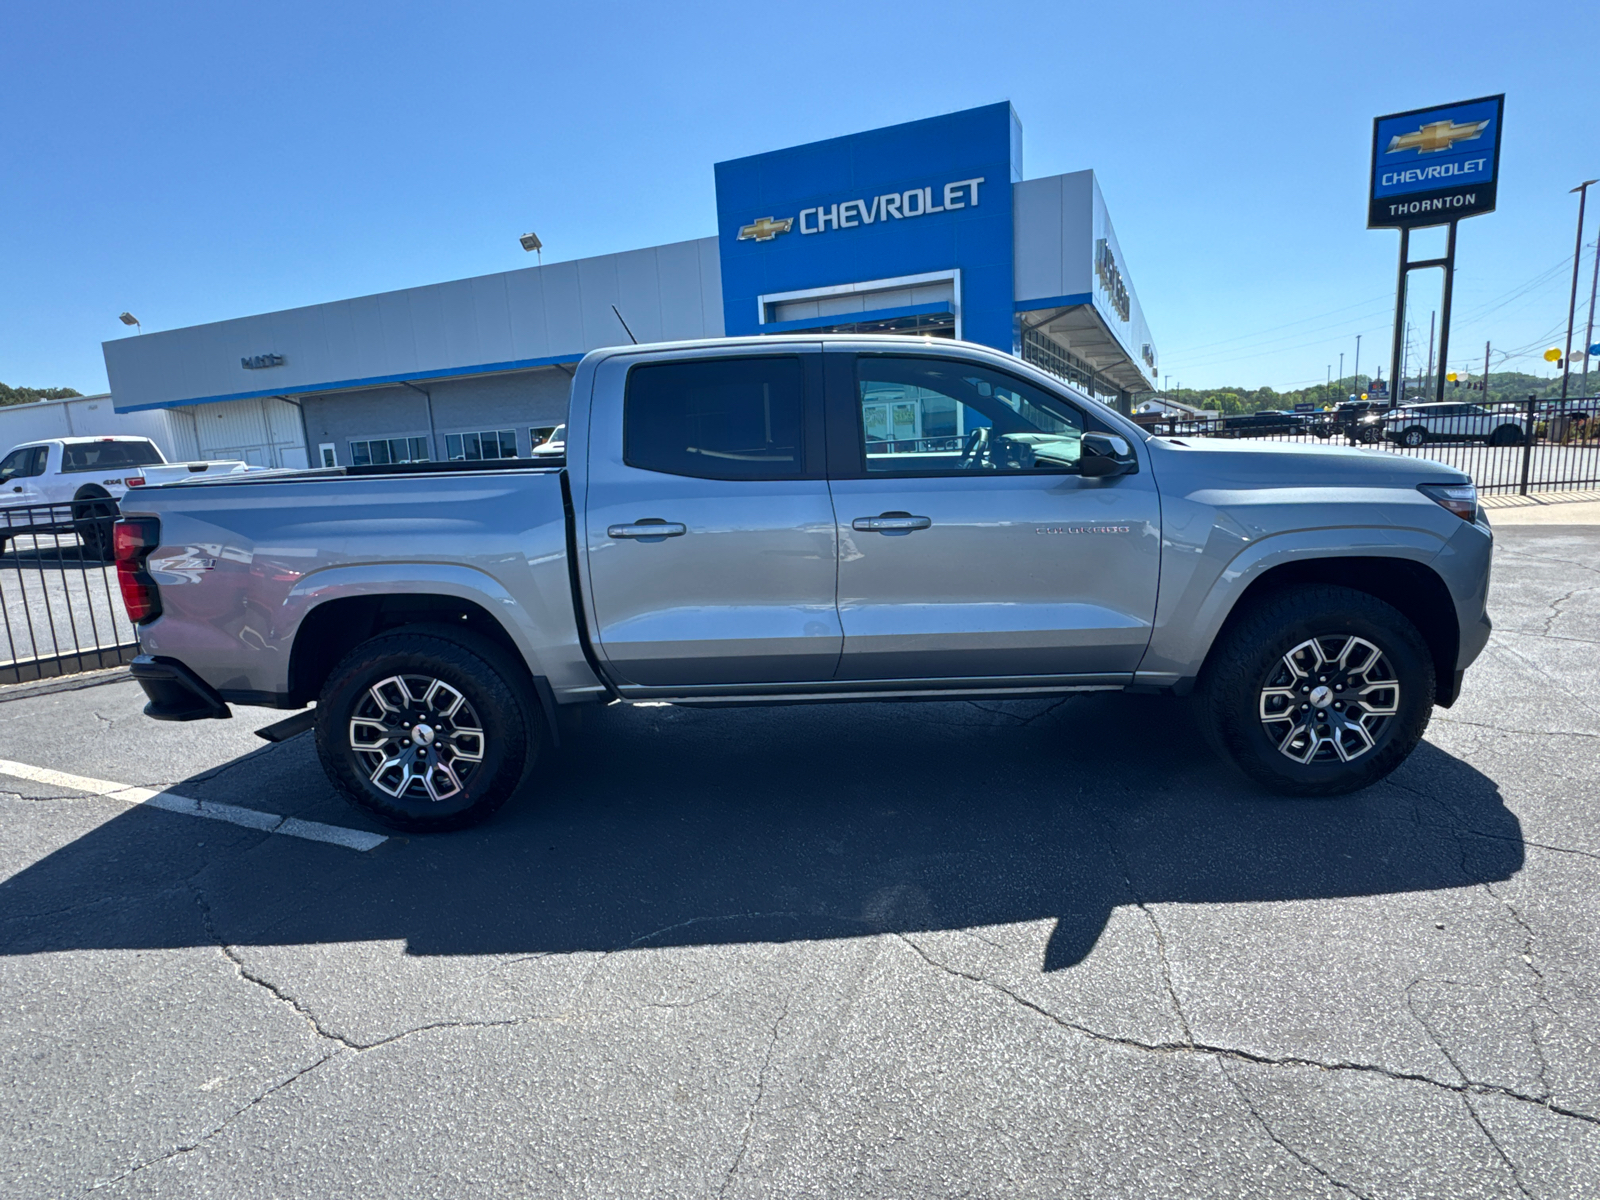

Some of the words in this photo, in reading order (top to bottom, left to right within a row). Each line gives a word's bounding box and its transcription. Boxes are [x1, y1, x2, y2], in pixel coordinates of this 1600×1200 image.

[1382, 158, 1487, 186] CHEVROLET
[799, 176, 986, 235] CHEVROLET
[1389, 193, 1477, 216] THORNTON
